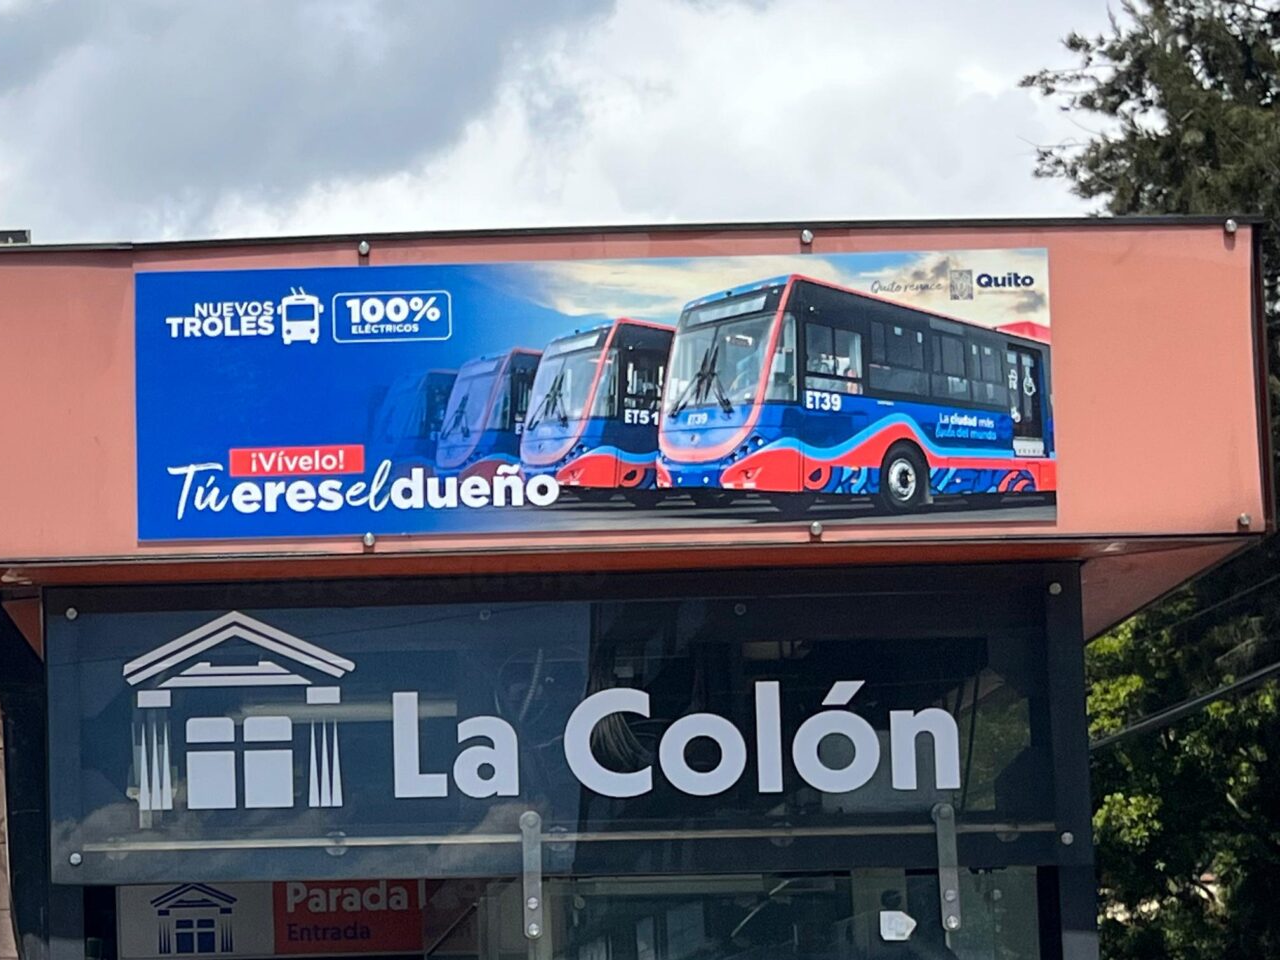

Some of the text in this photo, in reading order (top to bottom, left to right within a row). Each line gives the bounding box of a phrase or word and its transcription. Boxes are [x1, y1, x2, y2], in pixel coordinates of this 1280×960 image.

[871, 279, 902, 293] Quito
[976, 272, 1034, 288] Quito
[194, 301, 274, 318] NUEVOS
[345, 296, 441, 324] 100%
[166, 315, 275, 338] TROLES
[351, 322, 420, 335] ELÉCTRICOS
[805, 390, 842, 412] ET39
[250, 450, 345, 473] ¡Vívelo!
[232, 480, 344, 513] eres
[390, 463, 561, 510] dueño
[392, 679, 961, 798] La Colón
[286, 880, 409, 913] Parada
[287, 922, 371, 941] Entrada
